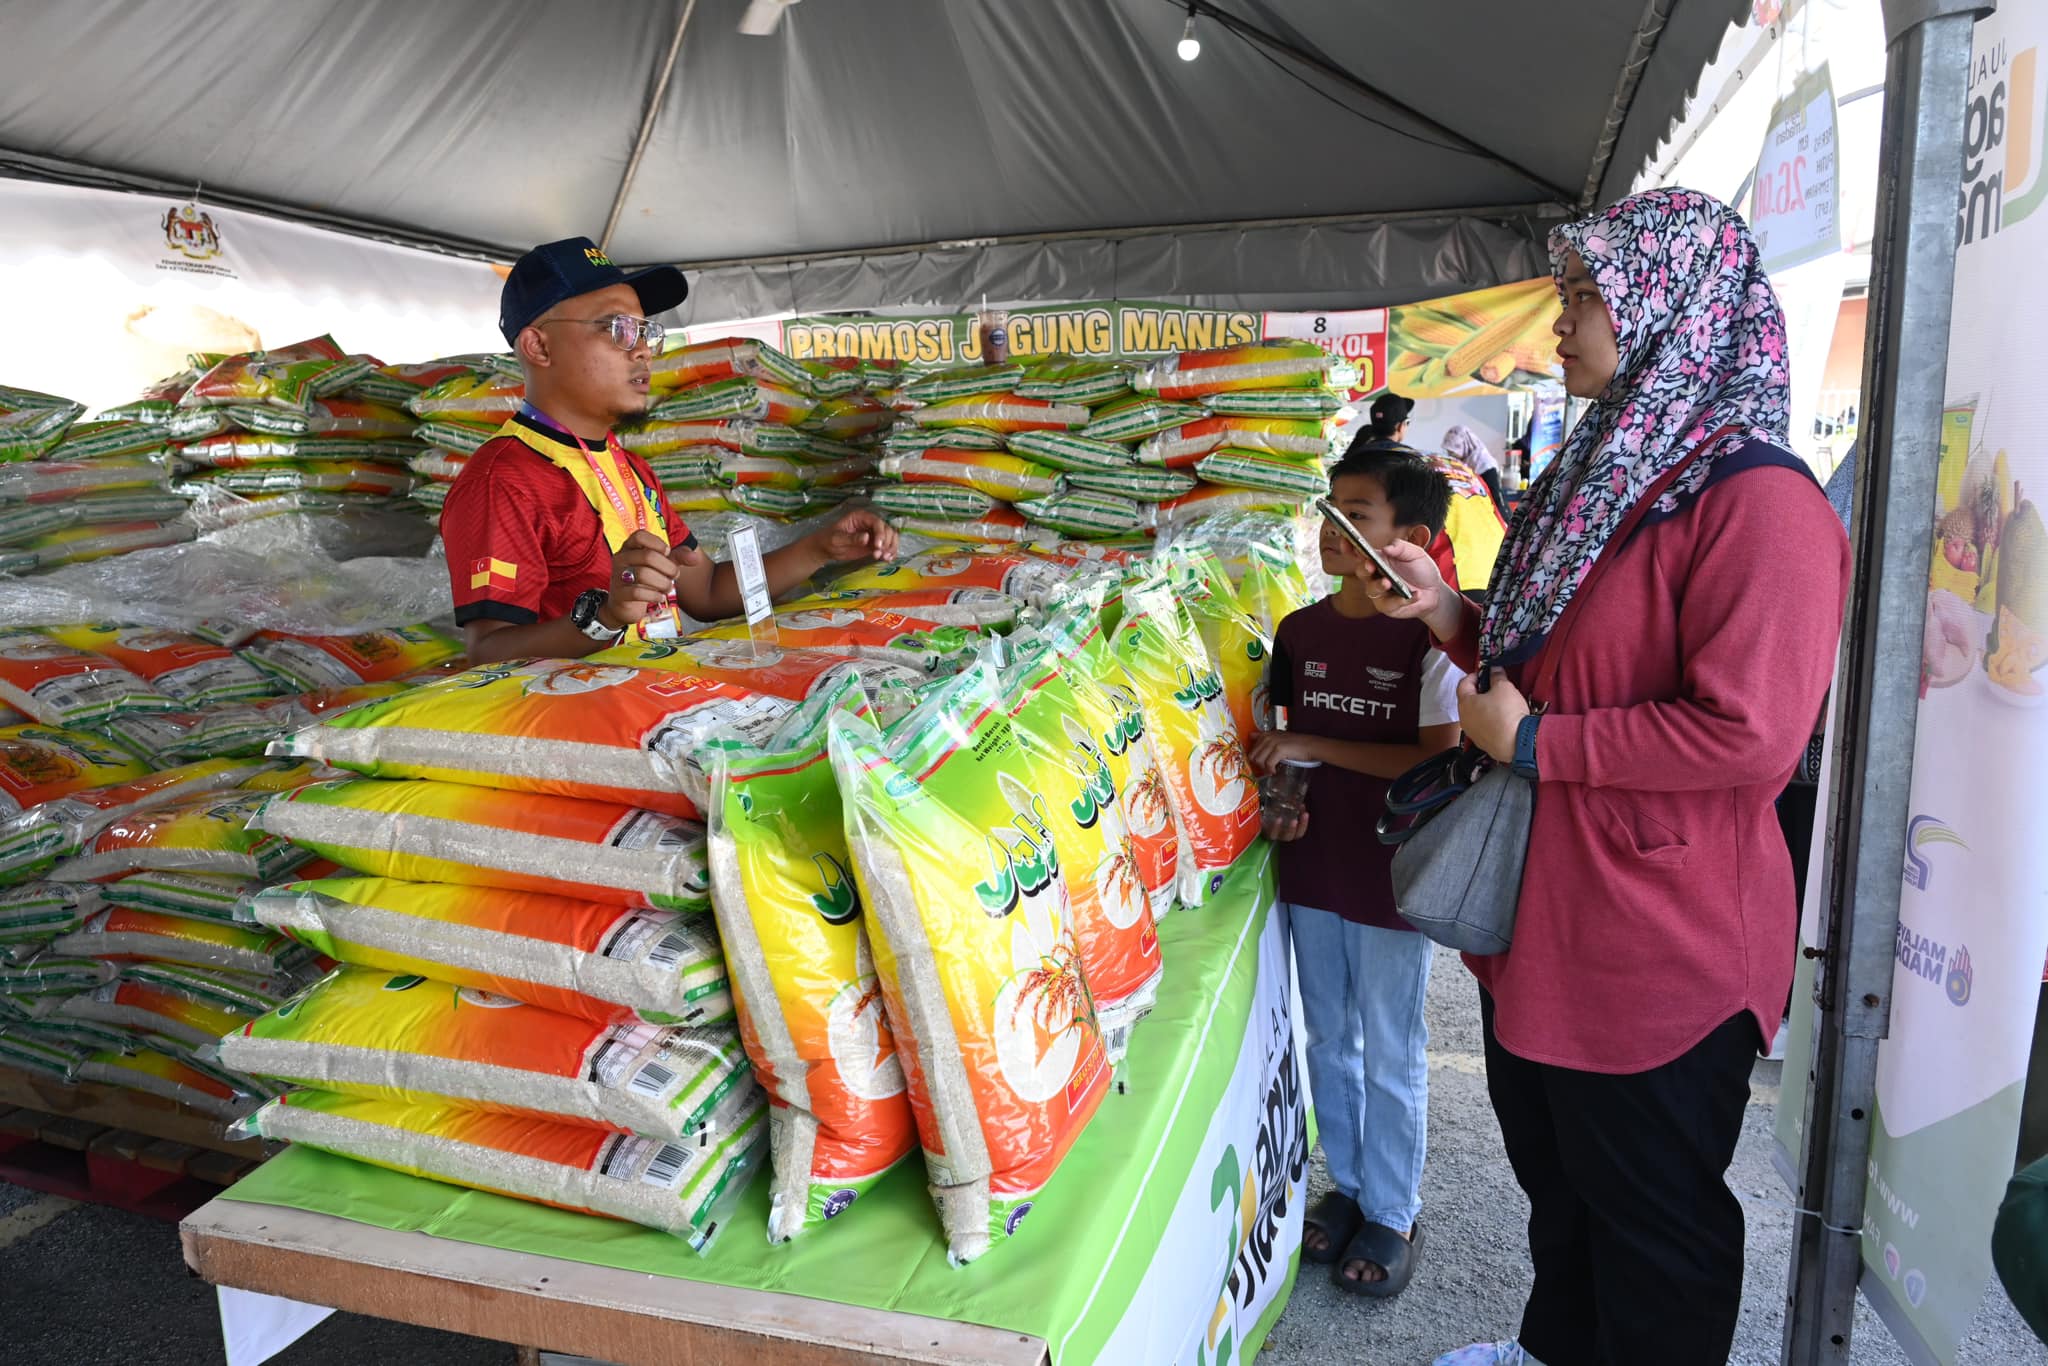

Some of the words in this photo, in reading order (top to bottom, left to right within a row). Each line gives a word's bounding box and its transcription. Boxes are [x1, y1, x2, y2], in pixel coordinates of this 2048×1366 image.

[789, 320, 953, 363] PROMOSI
[961, 309, 1112, 361] JGUNG
[1120, 307, 1257, 354] MANIS
[1313, 317, 1327, 333] 8
[1303, 690, 1397, 720] HACKETT
